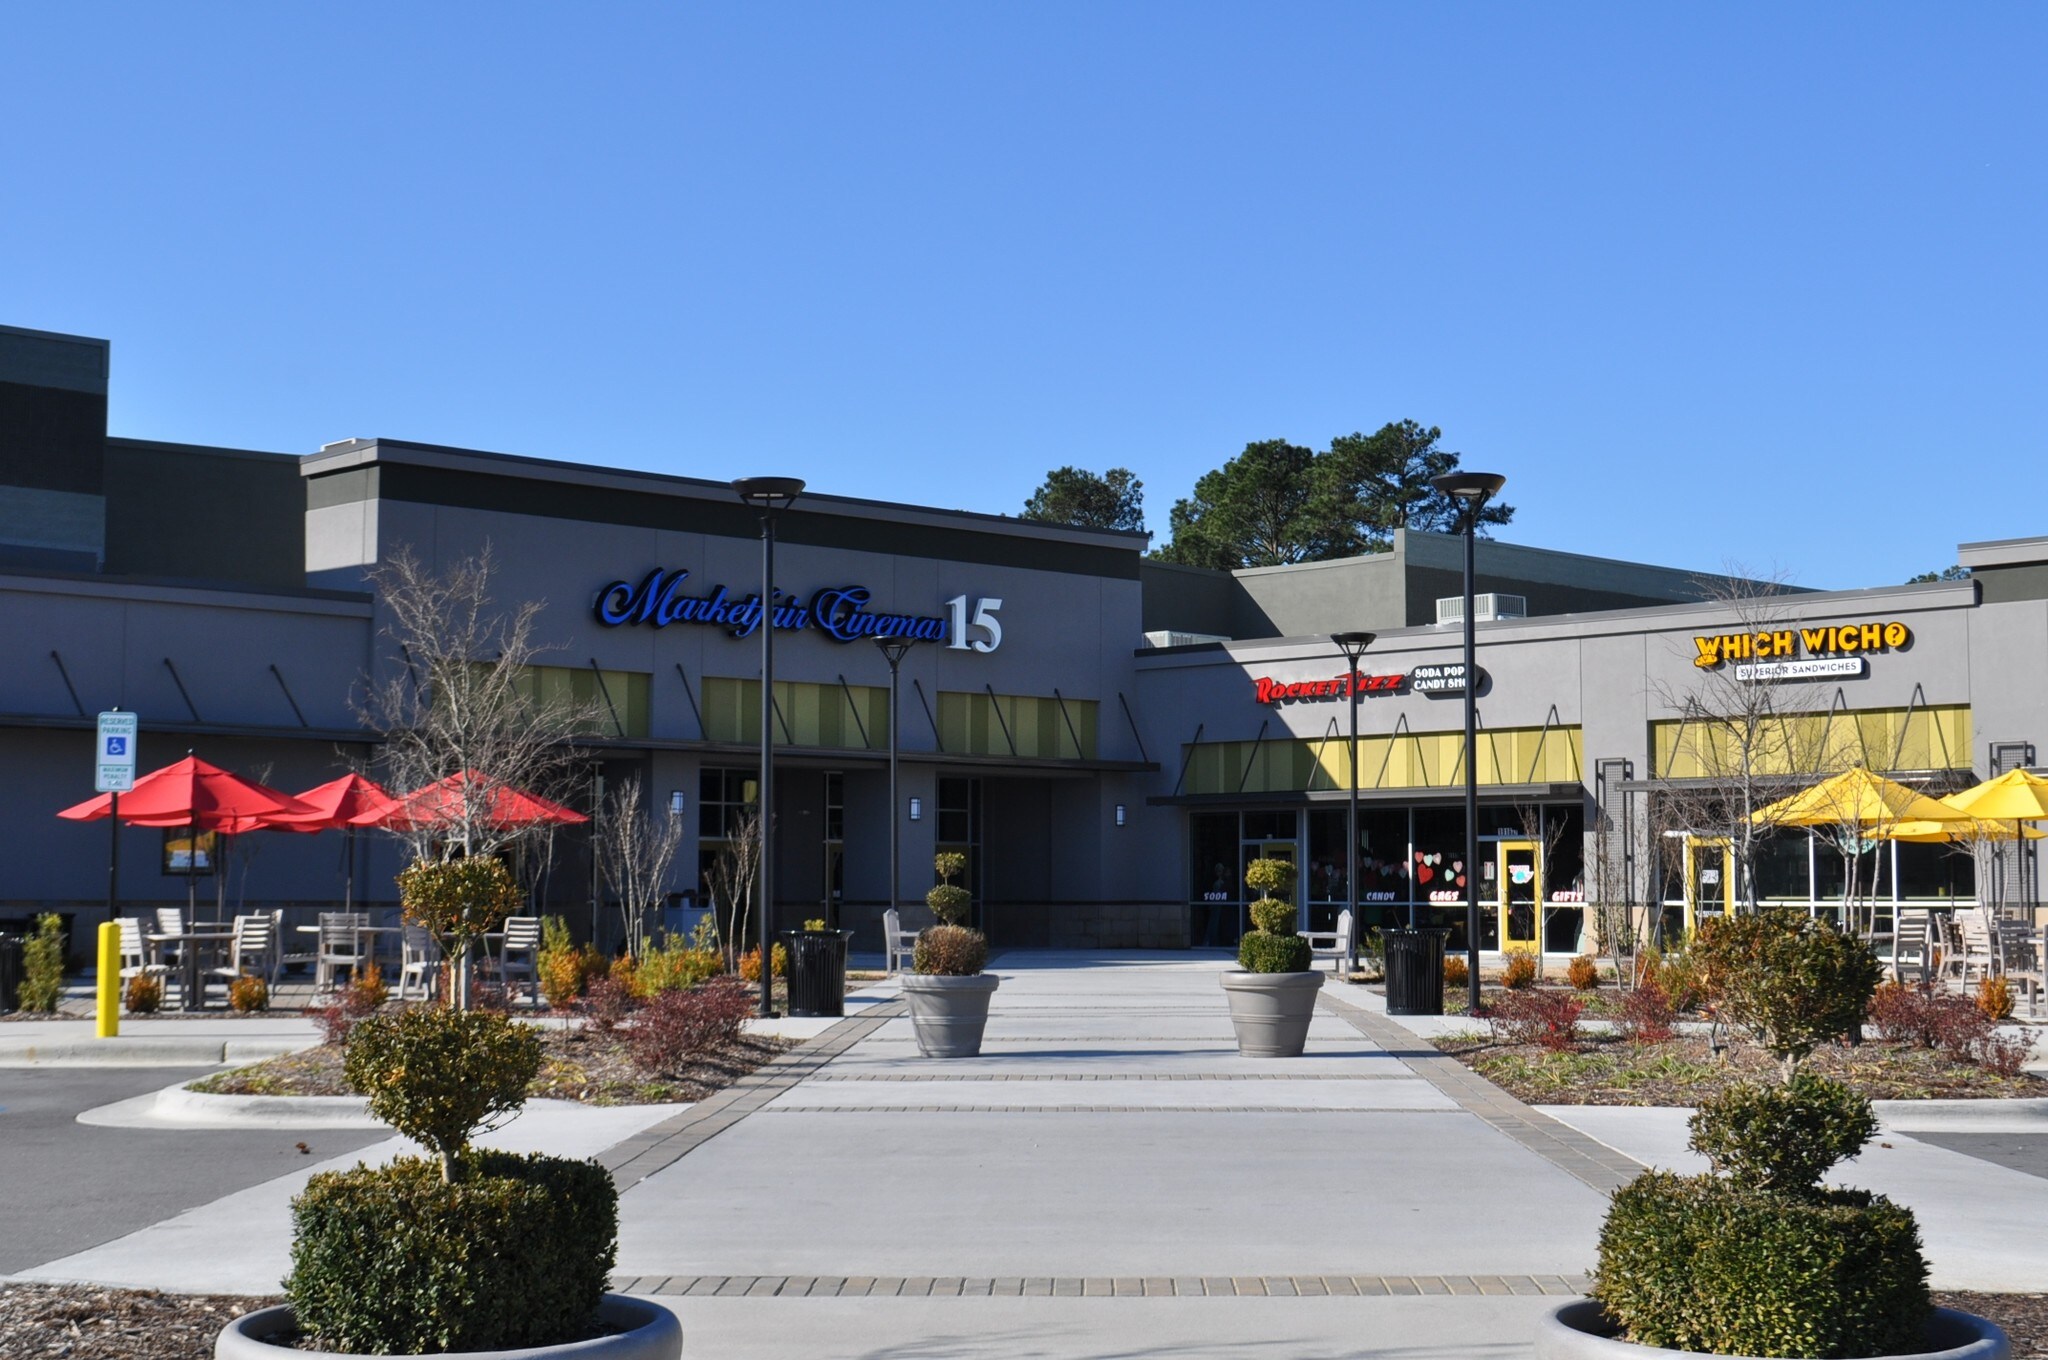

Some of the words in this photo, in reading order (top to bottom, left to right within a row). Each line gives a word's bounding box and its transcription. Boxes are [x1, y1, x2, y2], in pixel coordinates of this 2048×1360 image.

[814, 586, 947, 641] Cinemas
[945, 594, 1002, 653] 15
[1695, 630, 1793, 662] WHICH
[1415, 667, 1442, 678] SODA
[1443, 666, 1465, 677] POP
[1740, 665, 1789, 678] SUPERIOR
[1792, 662, 1858, 675] SANDWICHES
[1414, 679, 1446, 690] CANDY
[1203, 891, 1228, 901] SODA
[1366, 891, 1395, 901] CANDY
[1429, 890, 1459, 901] GAGS
[1552, 891, 1583, 902] GIFTS
